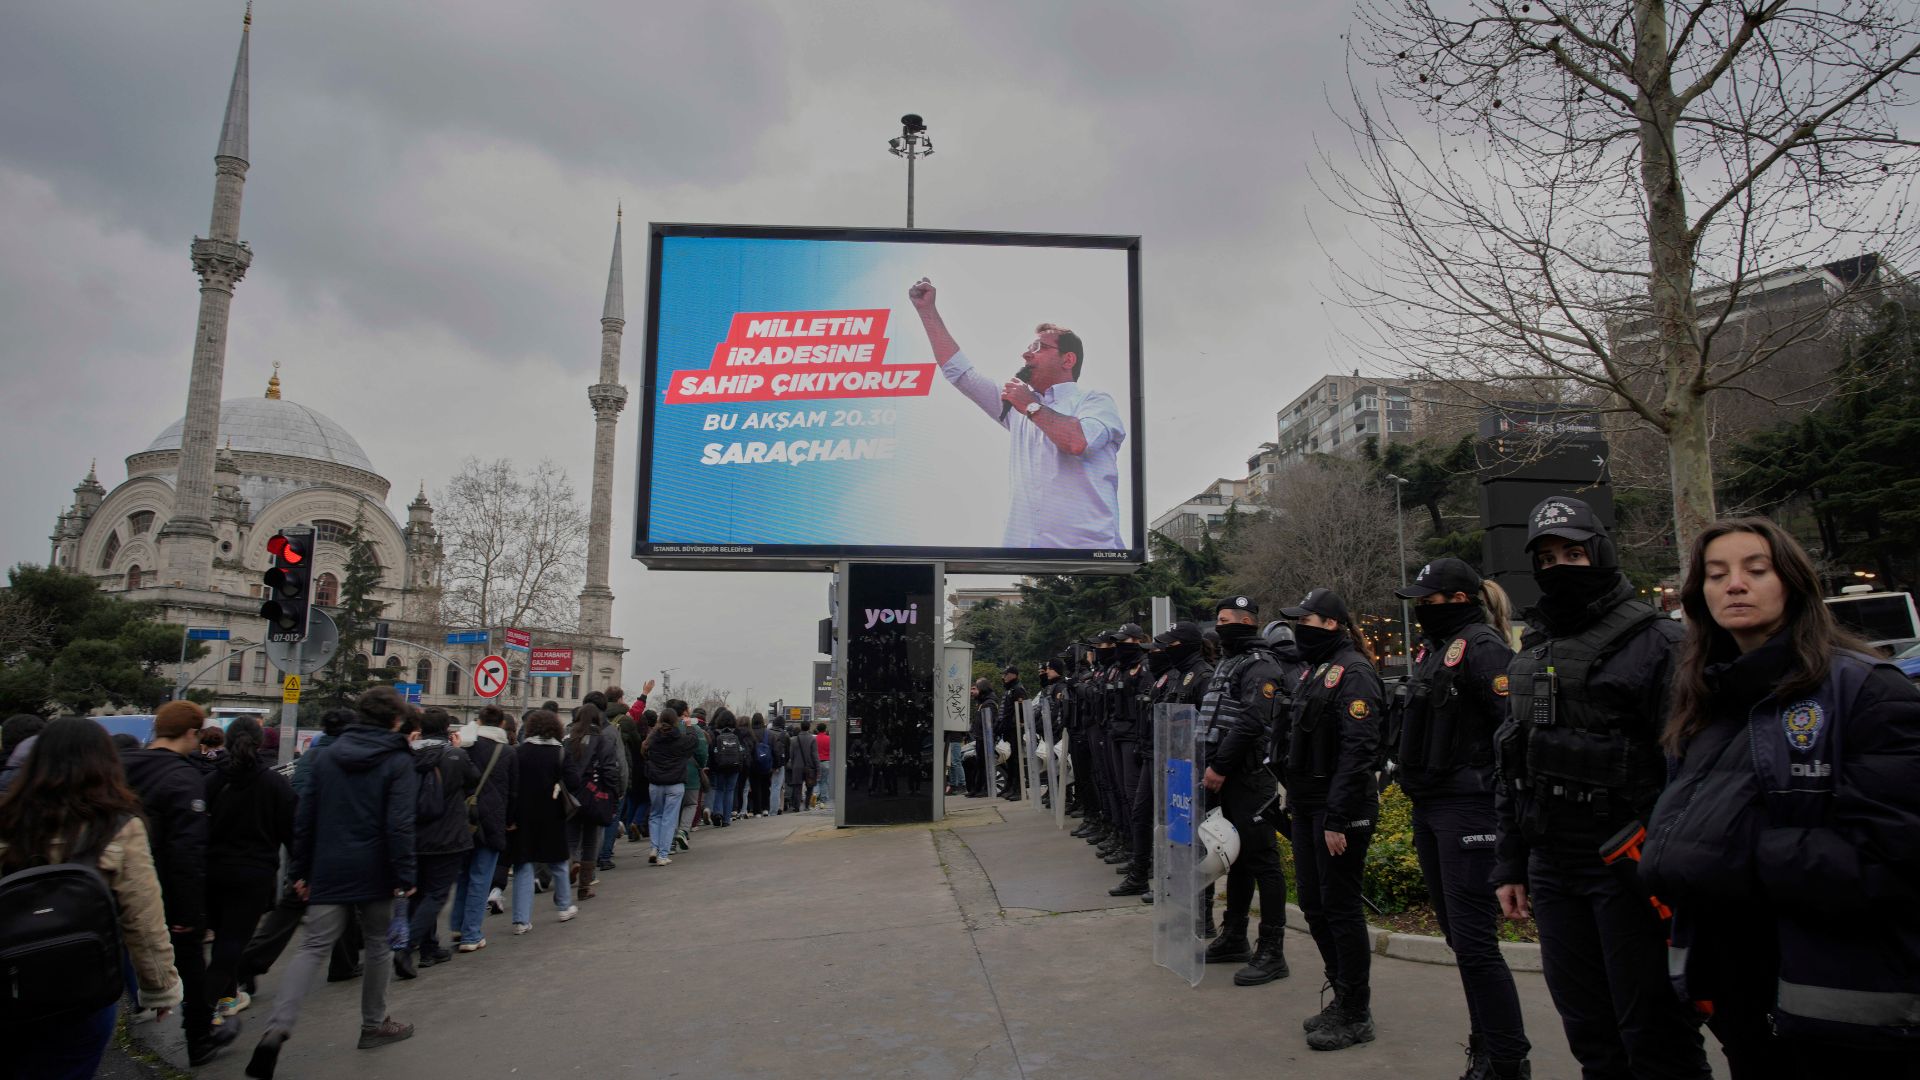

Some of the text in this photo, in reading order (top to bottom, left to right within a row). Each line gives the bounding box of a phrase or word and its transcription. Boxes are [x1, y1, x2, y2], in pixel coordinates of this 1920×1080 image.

[746, 316, 873, 339] MİLLETİN
[726, 343, 875, 367] İRADESİNE
[679, 370, 918, 397] SAHİP ÇIKIYORUZ
[703, 409, 898, 431] BU AKŞAM 20.30
[700, 438, 896, 467] SARAÇHANE
[653, 545, 681, 553] İSTANBUL
[682, 545, 719, 554] BÜYÜKŞEHİR
[864, 603, 917, 629] yovi
[273, 633, 300, 642] 07-012
[1172, 792, 1191, 810] POLİS
